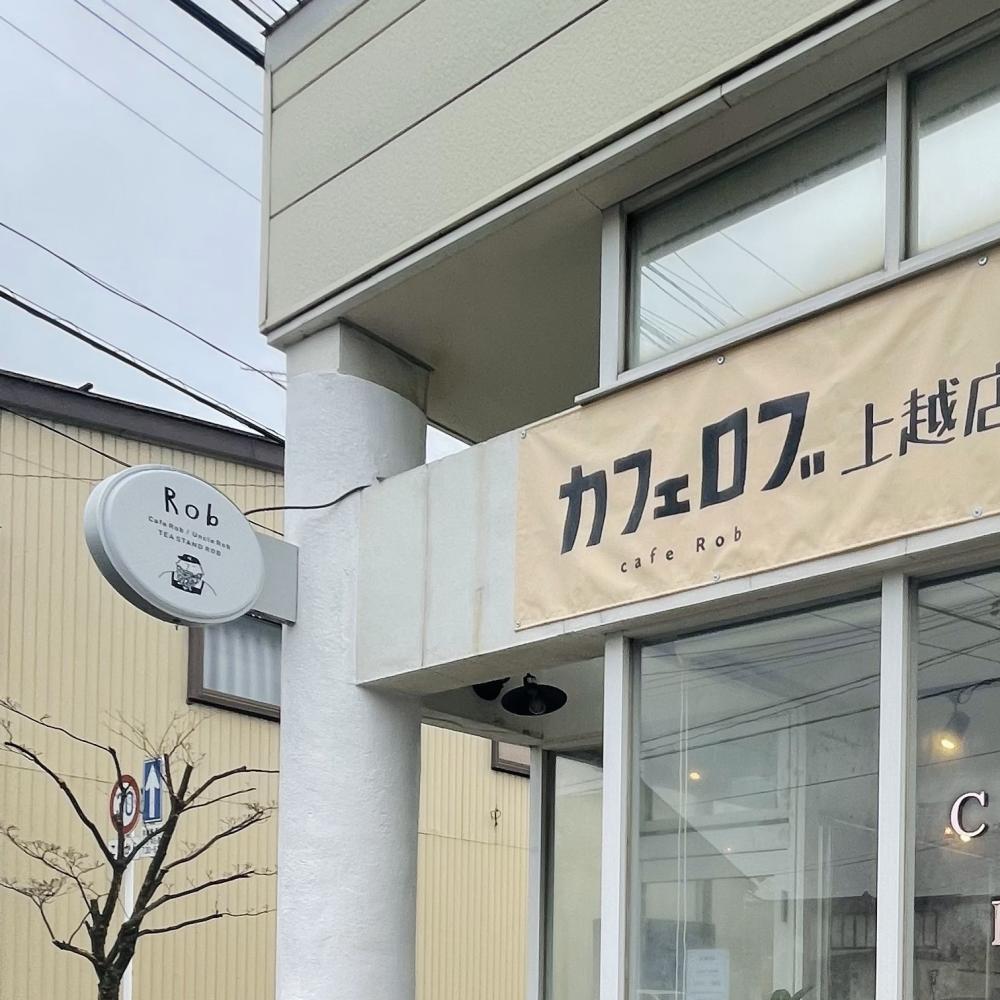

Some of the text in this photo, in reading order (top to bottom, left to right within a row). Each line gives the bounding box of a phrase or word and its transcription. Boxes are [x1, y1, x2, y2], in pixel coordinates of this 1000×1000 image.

[164, 487, 219, 527] Rob
[619, 526, 743, 575] cafe Rob
